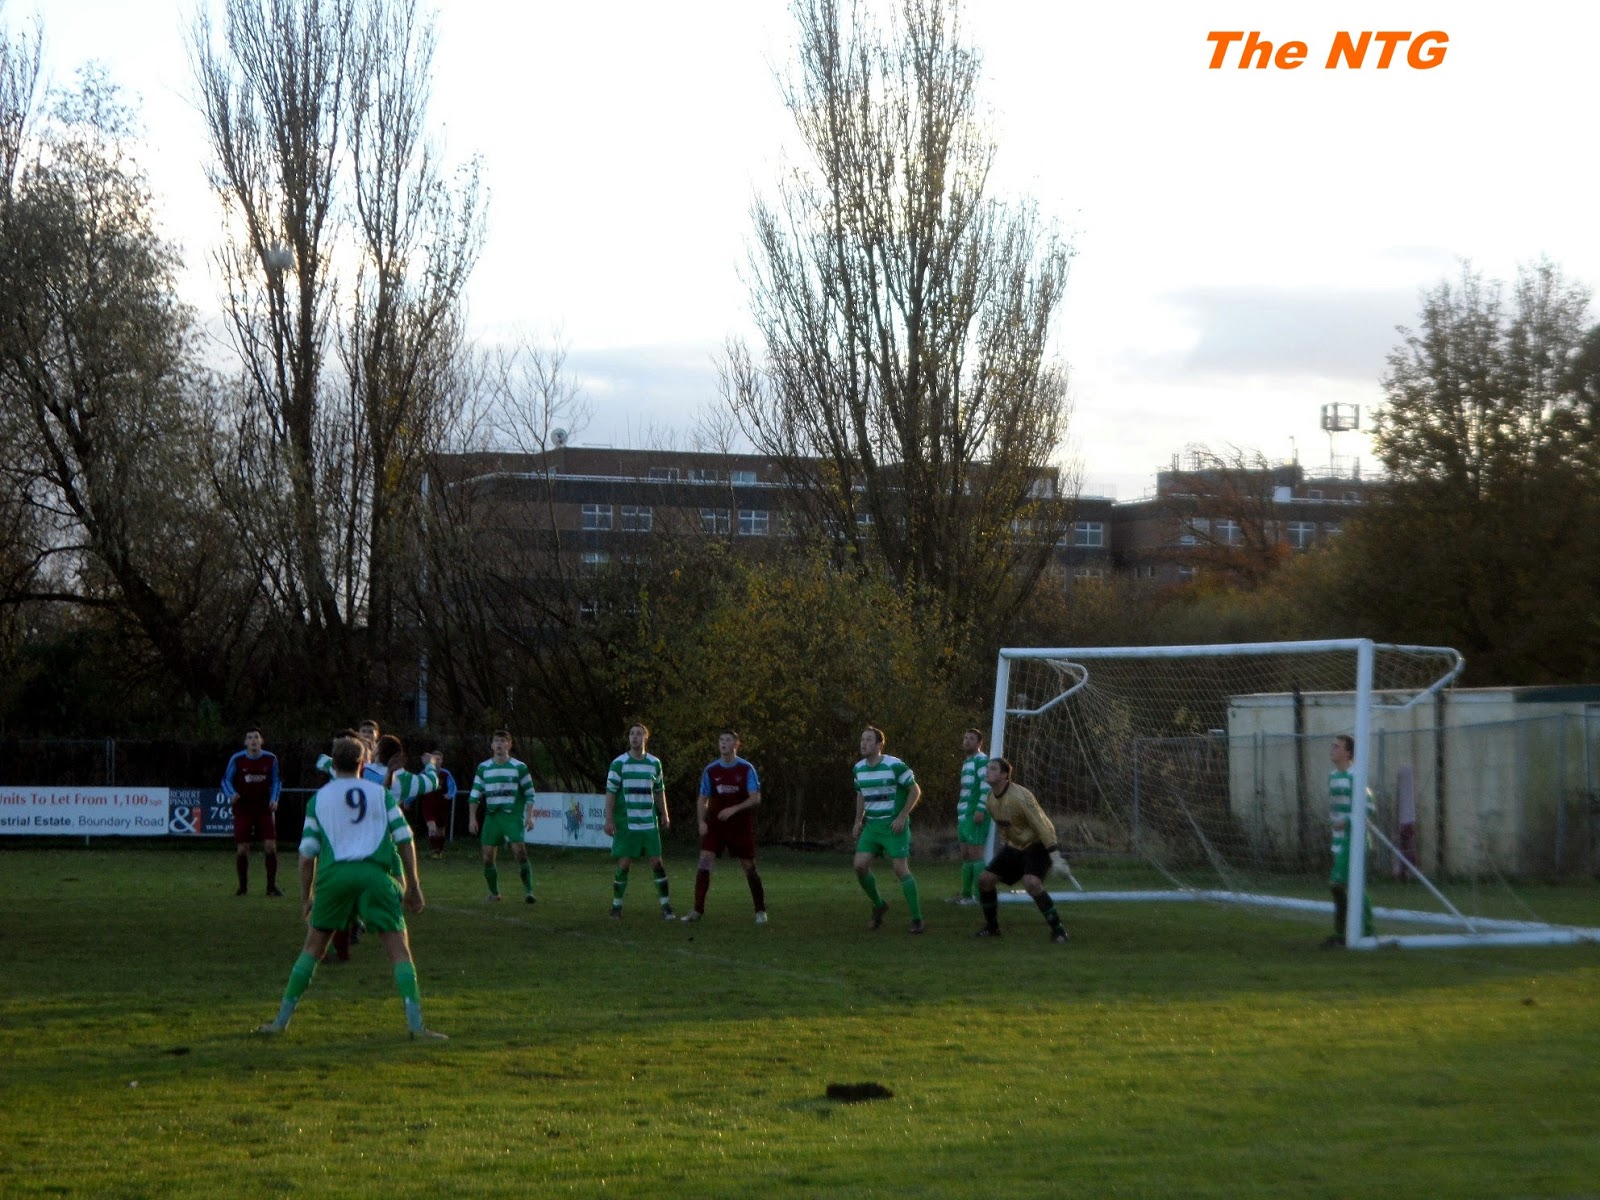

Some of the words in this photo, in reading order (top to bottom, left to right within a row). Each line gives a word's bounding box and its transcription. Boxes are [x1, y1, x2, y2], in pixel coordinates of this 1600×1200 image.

[31, 793, 47, 804] To
[51, 793, 69, 804] Let
[74, 794, 107, 804] From
[113, 794, 148, 806] 1,100
[346, 788, 367, 824] 9
[0, 816, 30, 826] strial
[78, 816, 131, 828] Boundary
[134, 816, 164, 826] Road
